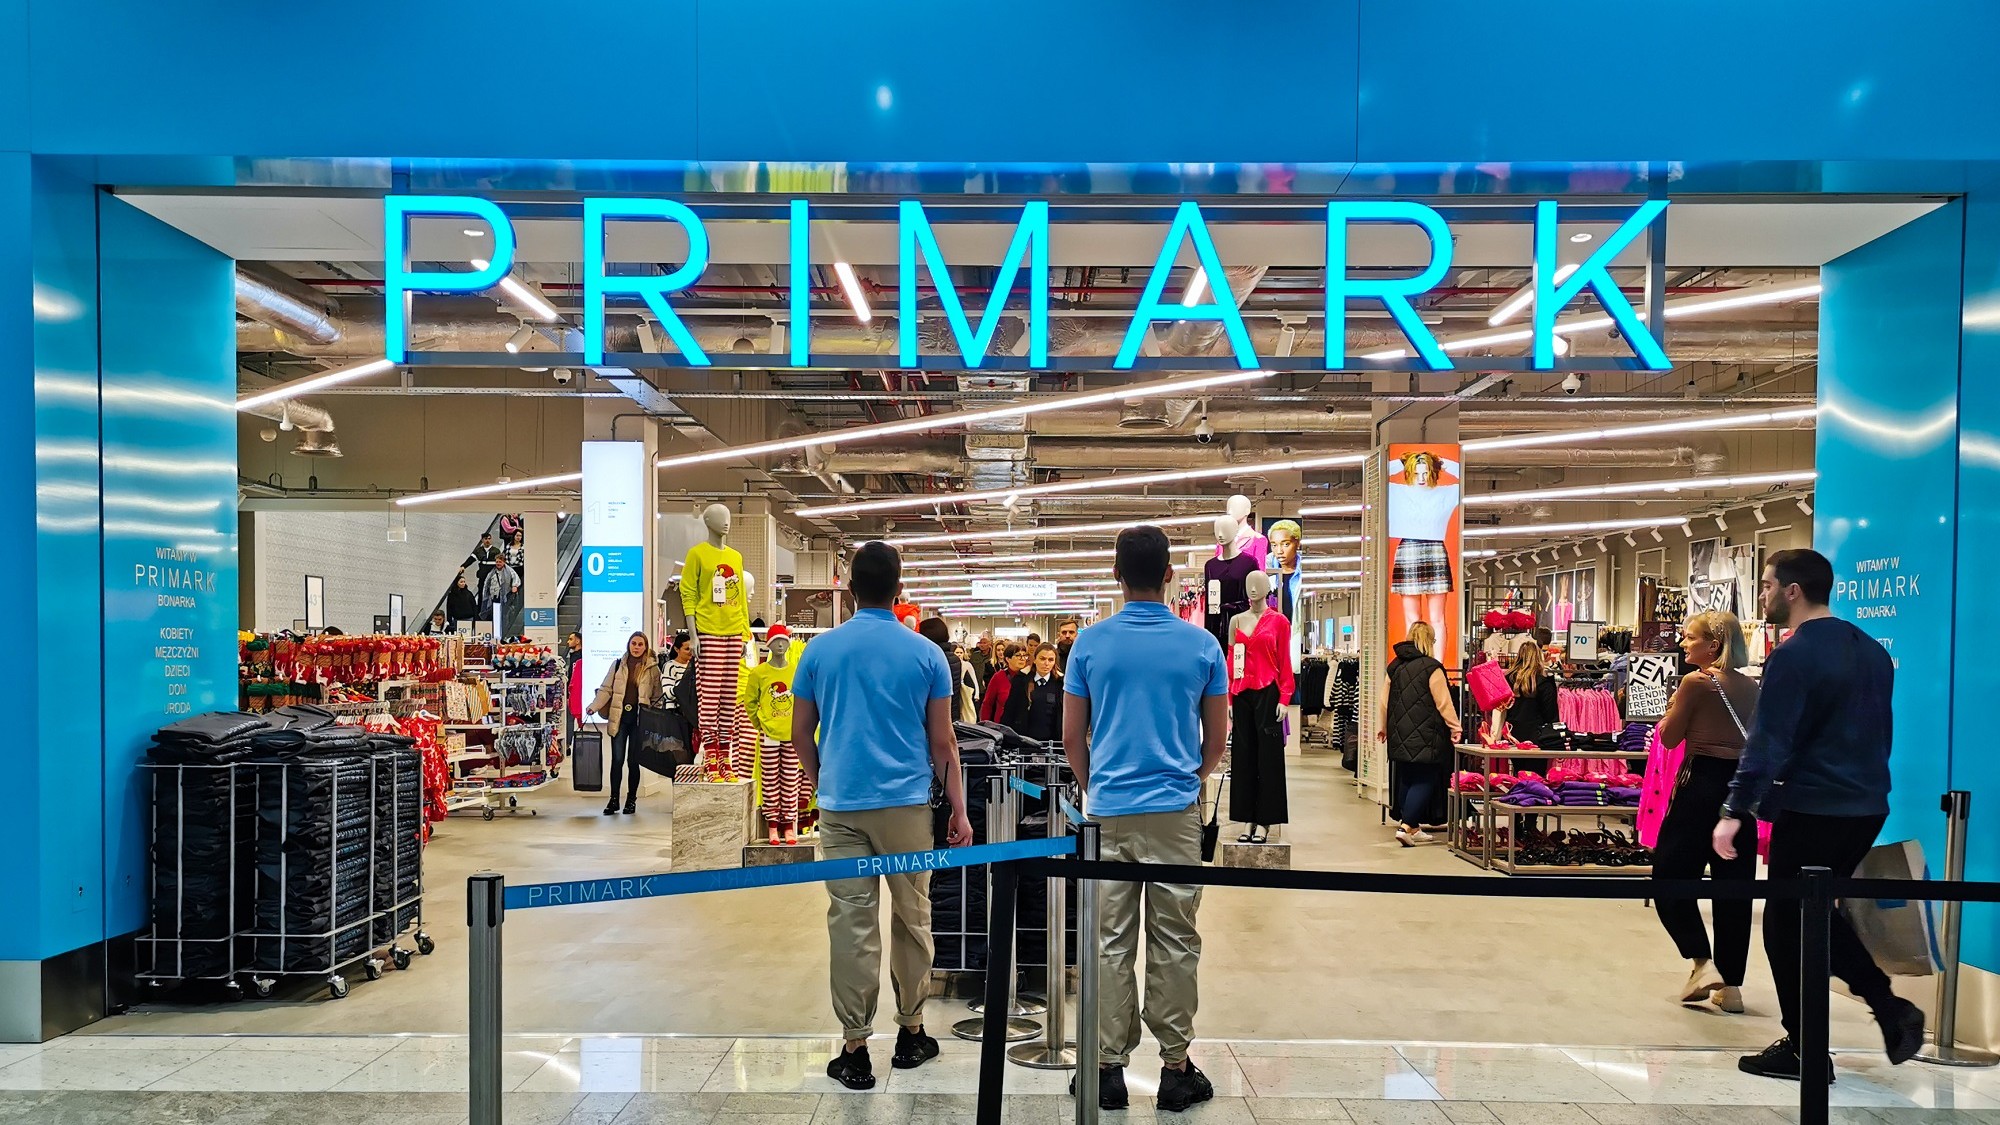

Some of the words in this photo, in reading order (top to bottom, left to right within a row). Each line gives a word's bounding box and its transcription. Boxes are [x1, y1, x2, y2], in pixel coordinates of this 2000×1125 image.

[384, 195, 1671, 370] PRIMARK
[156, 547, 187, 561] WITAMY
[189, 551, 197, 563] W
[587, 552, 605, 576] 0
[1856, 558, 1889, 573] WITAMY
[1890, 557, 1899, 569] W
[135, 564, 215, 592] PRIMARK
[1836, 573, 1920, 601] PRIMARK
[157, 594, 196, 608] BONARKA
[1856, 605, 1897, 619] BONARKA
[160, 627, 193, 640] KOBIETY
[1574, 635, 1588, 645] 70
[164, 665, 190, 677] DZIECI
[168, 683, 187, 695] DOM
[164, 702, 191, 714] URODA
